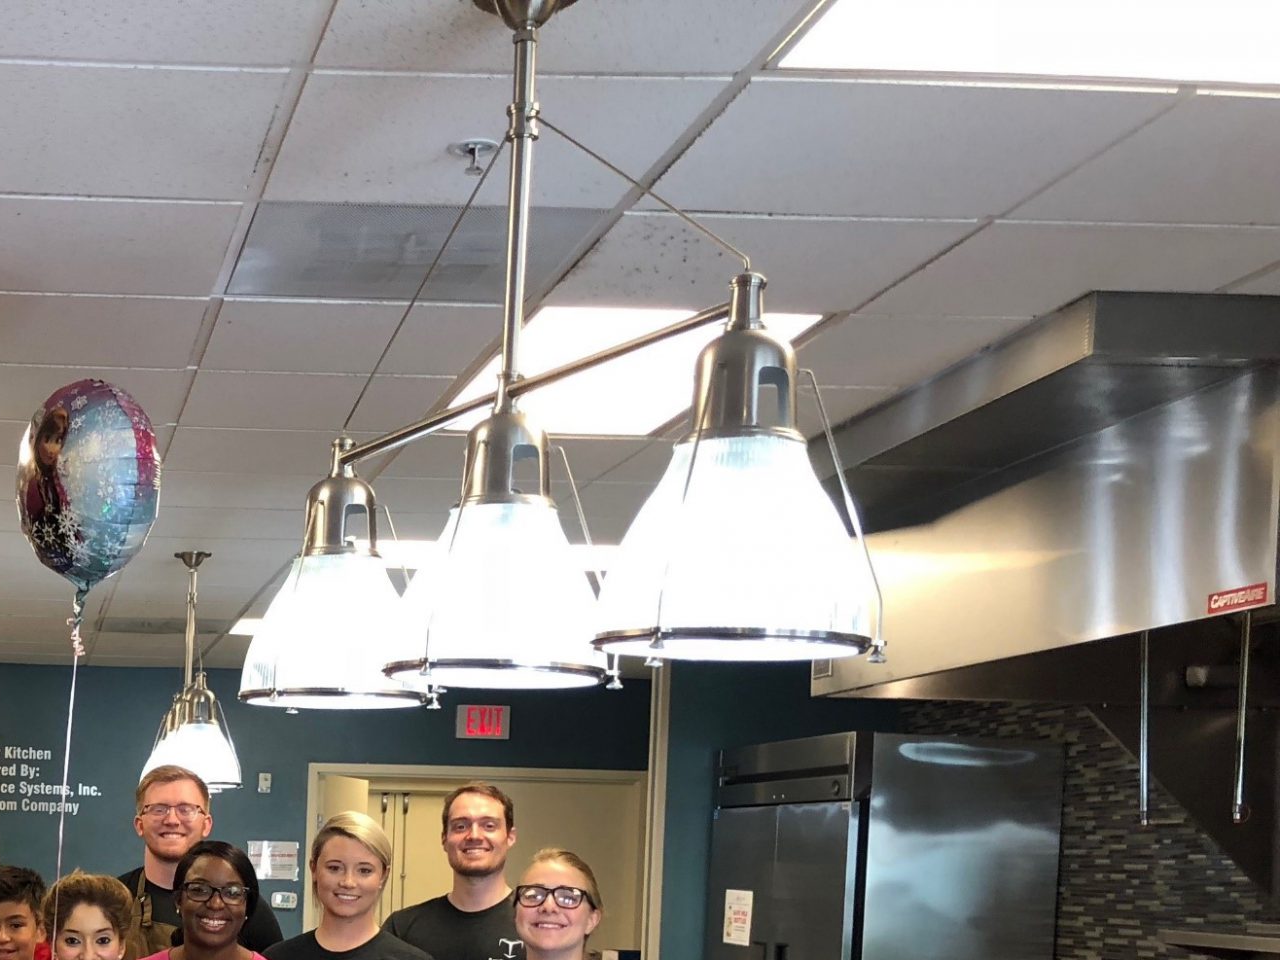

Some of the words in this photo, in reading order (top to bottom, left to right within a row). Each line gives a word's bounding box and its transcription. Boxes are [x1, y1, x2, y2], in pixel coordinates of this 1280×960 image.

[465, 705, 504, 736] EXIT
[4, 746, 52, 761] Kitchen
[20, 764, 40, 779] By:
[19, 782, 74, 797] Systems,
[78, 783, 102, 797] Inc.
[21, 798, 80, 815] Company
